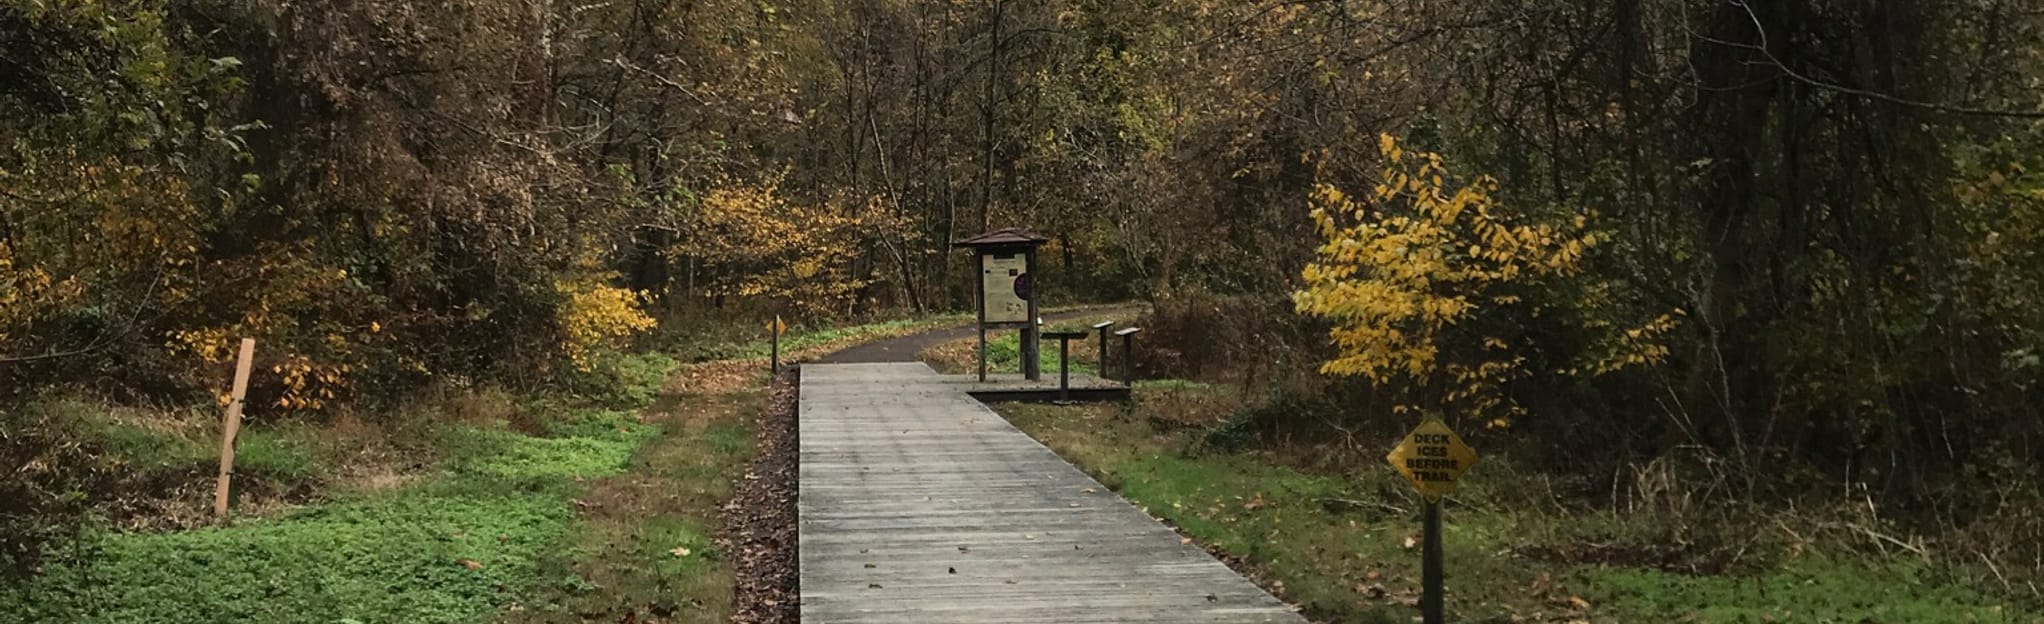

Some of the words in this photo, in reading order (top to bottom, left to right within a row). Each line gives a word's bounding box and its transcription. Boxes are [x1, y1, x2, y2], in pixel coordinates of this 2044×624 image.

[1414, 434, 1450, 444] DECK
[1417, 446, 1447, 456] ICES
[1406, 458, 1458, 469] BEFORE
[1413, 471, 1453, 481] TRAIL
